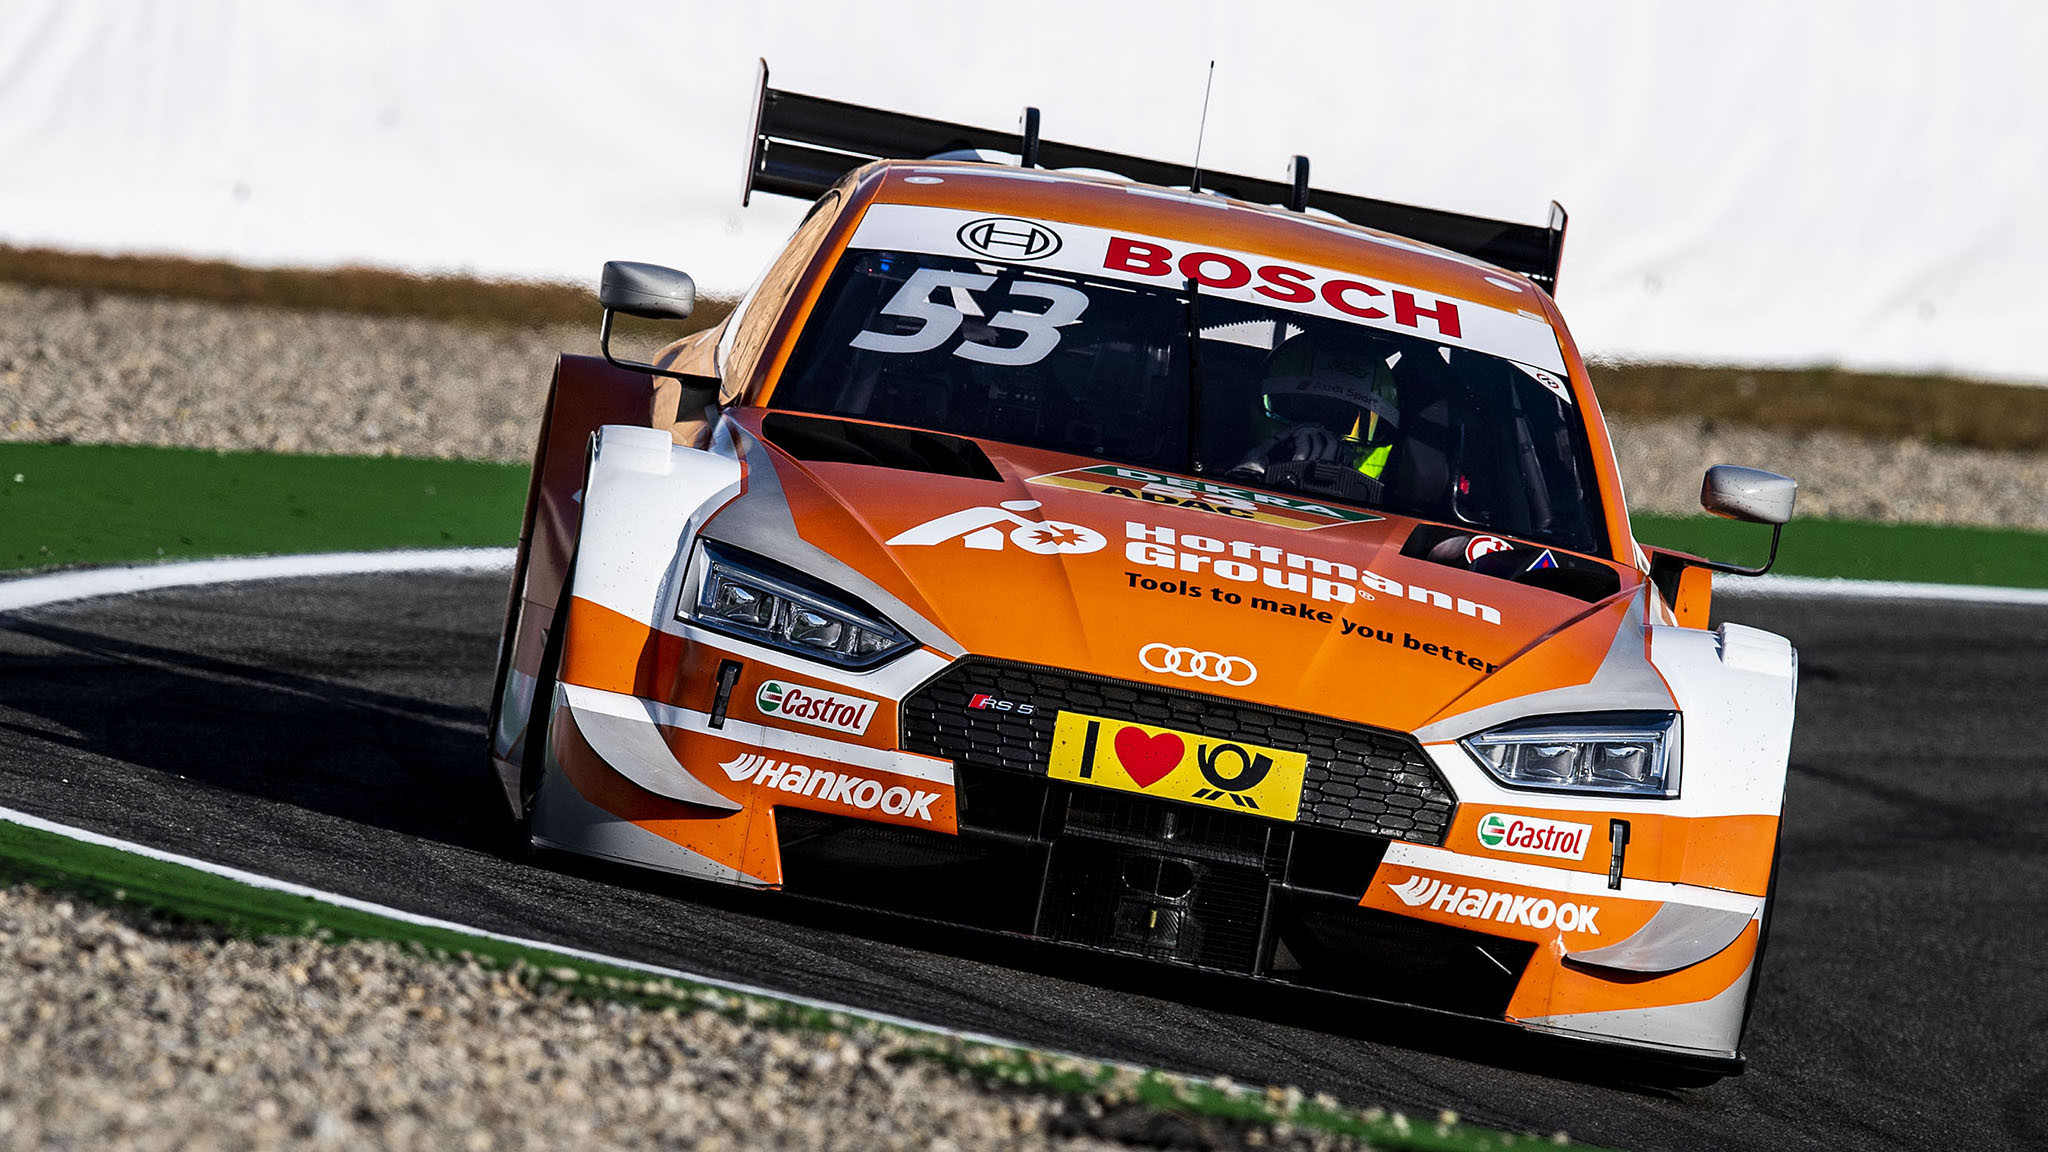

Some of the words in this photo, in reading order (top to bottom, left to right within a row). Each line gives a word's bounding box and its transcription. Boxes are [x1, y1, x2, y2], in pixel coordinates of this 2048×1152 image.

[1103, 236, 1462, 339] BOSCH
[848, 267, 1090, 366] 53
[1100, 486, 1255, 519] ADAC
[1116, 468, 1345, 518] DEKRA
[1141, 482, 1258, 511] 53
[1125, 521, 1501, 626] Hoffmann
[1125, 572, 1202, 598] Tools
[1210, 587, 1242, 605] to
[1250, 596, 1334, 624] make
[1340, 617, 1394, 645] you
[1402, 632, 1499, 675] better
[780, 688, 867, 731] Castrol
[979, 698, 1014, 713] RS
[1016, 704, 1035, 716] 5
[1080, 720, 1101, 779] I
[1506, 820, 1583, 854] Castrol
